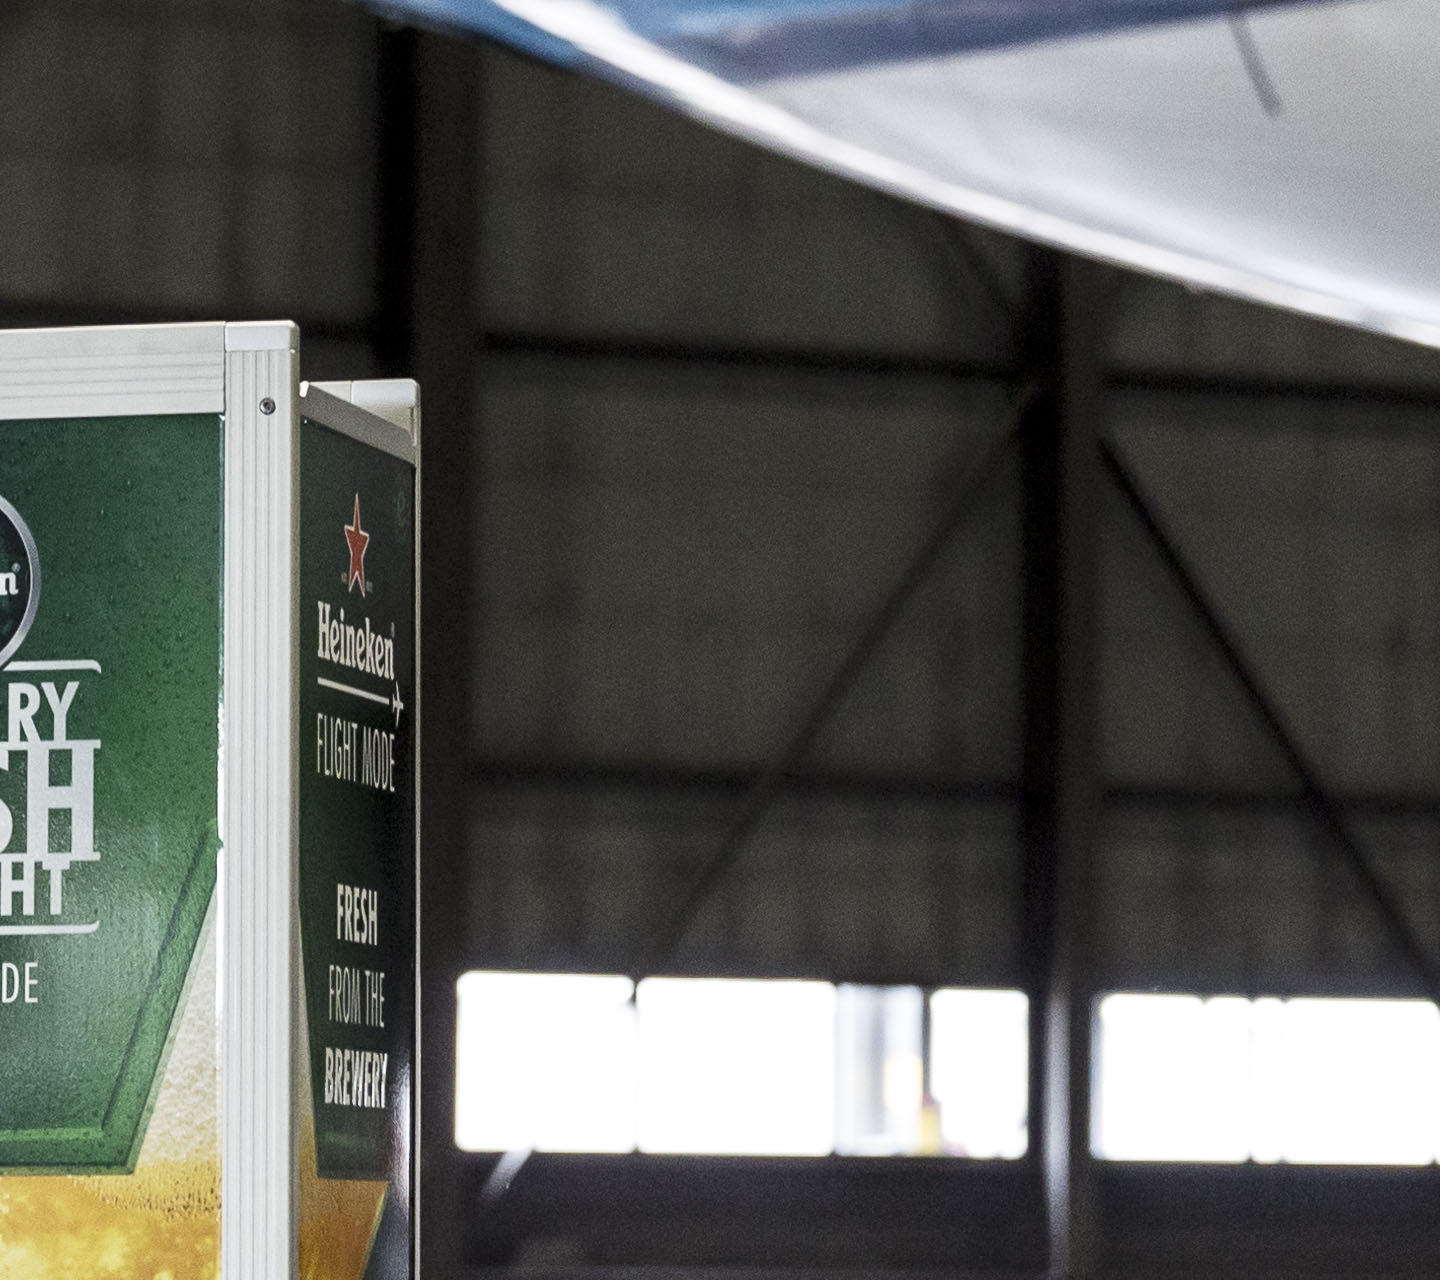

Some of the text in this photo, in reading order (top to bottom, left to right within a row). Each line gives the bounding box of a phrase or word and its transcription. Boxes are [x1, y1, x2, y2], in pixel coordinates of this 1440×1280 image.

[317, 712, 395, 792] FLIGHT MODE
[337, 883, 378, 946] FRESH
[328, 964, 385, 1028] FROM THE
[324, 1047, 388, 1109] BREWERY
